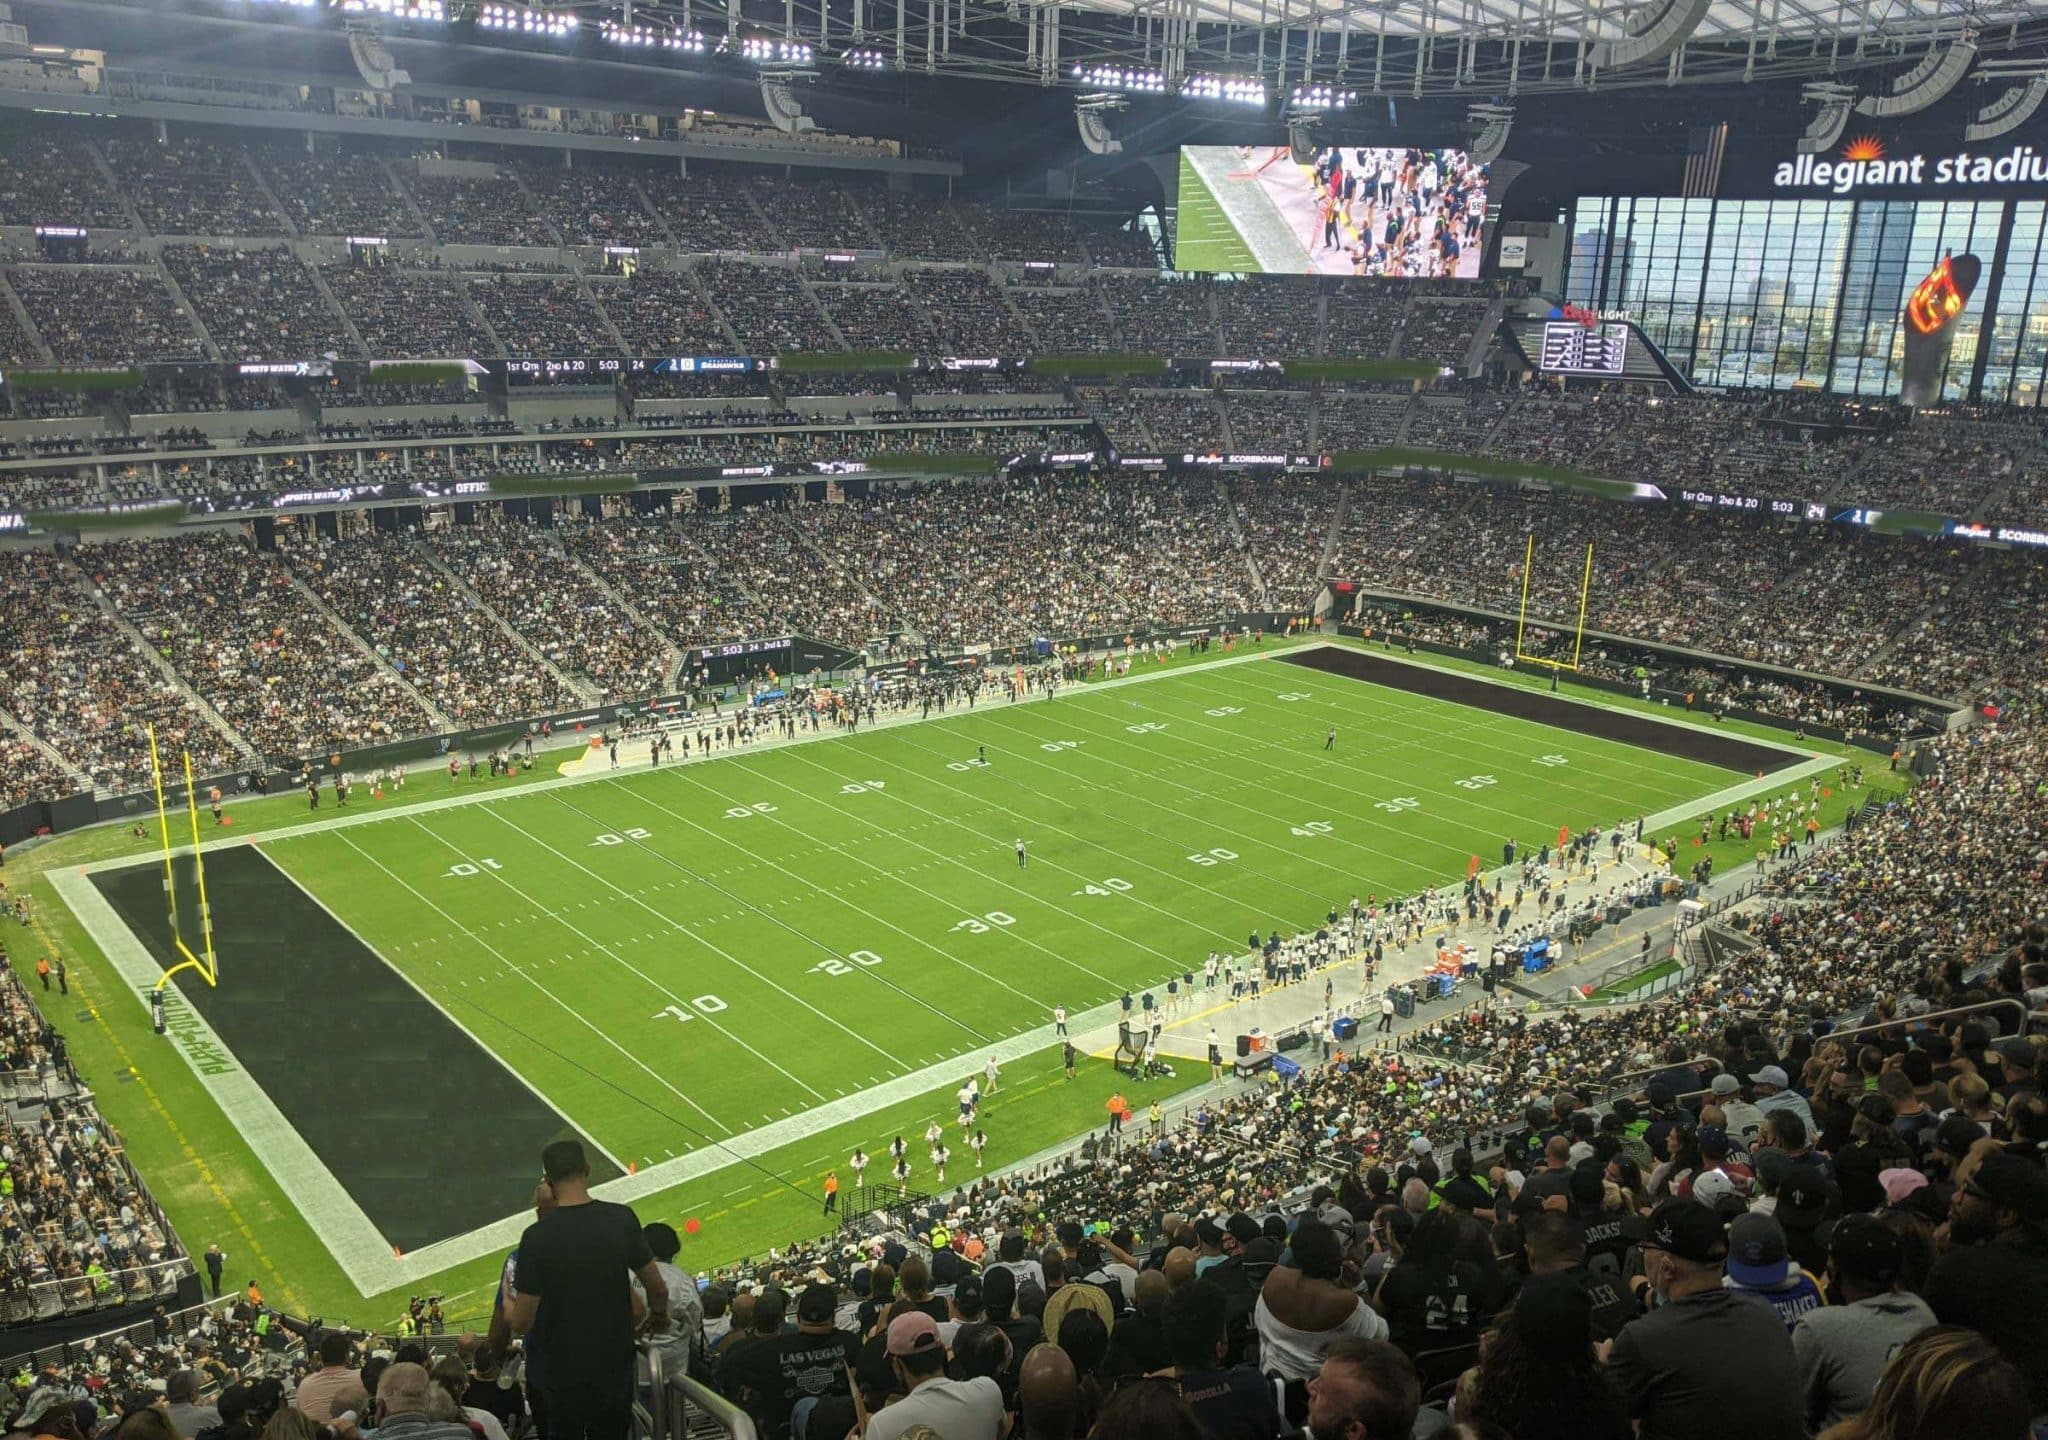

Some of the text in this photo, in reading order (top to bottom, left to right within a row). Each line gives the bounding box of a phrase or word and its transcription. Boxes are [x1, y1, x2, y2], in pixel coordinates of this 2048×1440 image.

[1774, 154, 1925, 193] allegiant
[1598, 309, 1630, 320] LIGHT
[563, 361, 570, 370] &
[572, 361, 585, 370] 20
[600, 361, 619, 370] 5:03
[633, 361, 645, 370] 24
[1229, 455, 1284, 464] SCOREBOARD
[1735, 498, 1743, 506] &
[1745, 498, 1758, 508] 20
[1772, 501, 1793, 512] 5:03
[1808, 505, 1825, 518] 24
[749, 643, 759, 652] 24
[842, 781, 886, 793] 40
[1454, 775, 1498, 789] 20
[726, 802, 778, 818] 30
[1373, 797, 1420, 812] 30
[1290, 821, 1333, 836] 40
[596, 828, 652, 845] 20
[1186, 848, 1239, 866] 50
[450, 858, 504, 876] 10
[1085, 878, 1134, 896] 40
[957, 911, 1017, 934] 30
[818, 950, 883, 976] 20
[665, 995, 729, 1022] 10
[1425, 1294, 1469, 1330] 24
[780, 1344, 847, 1364] LAS VEGAS
